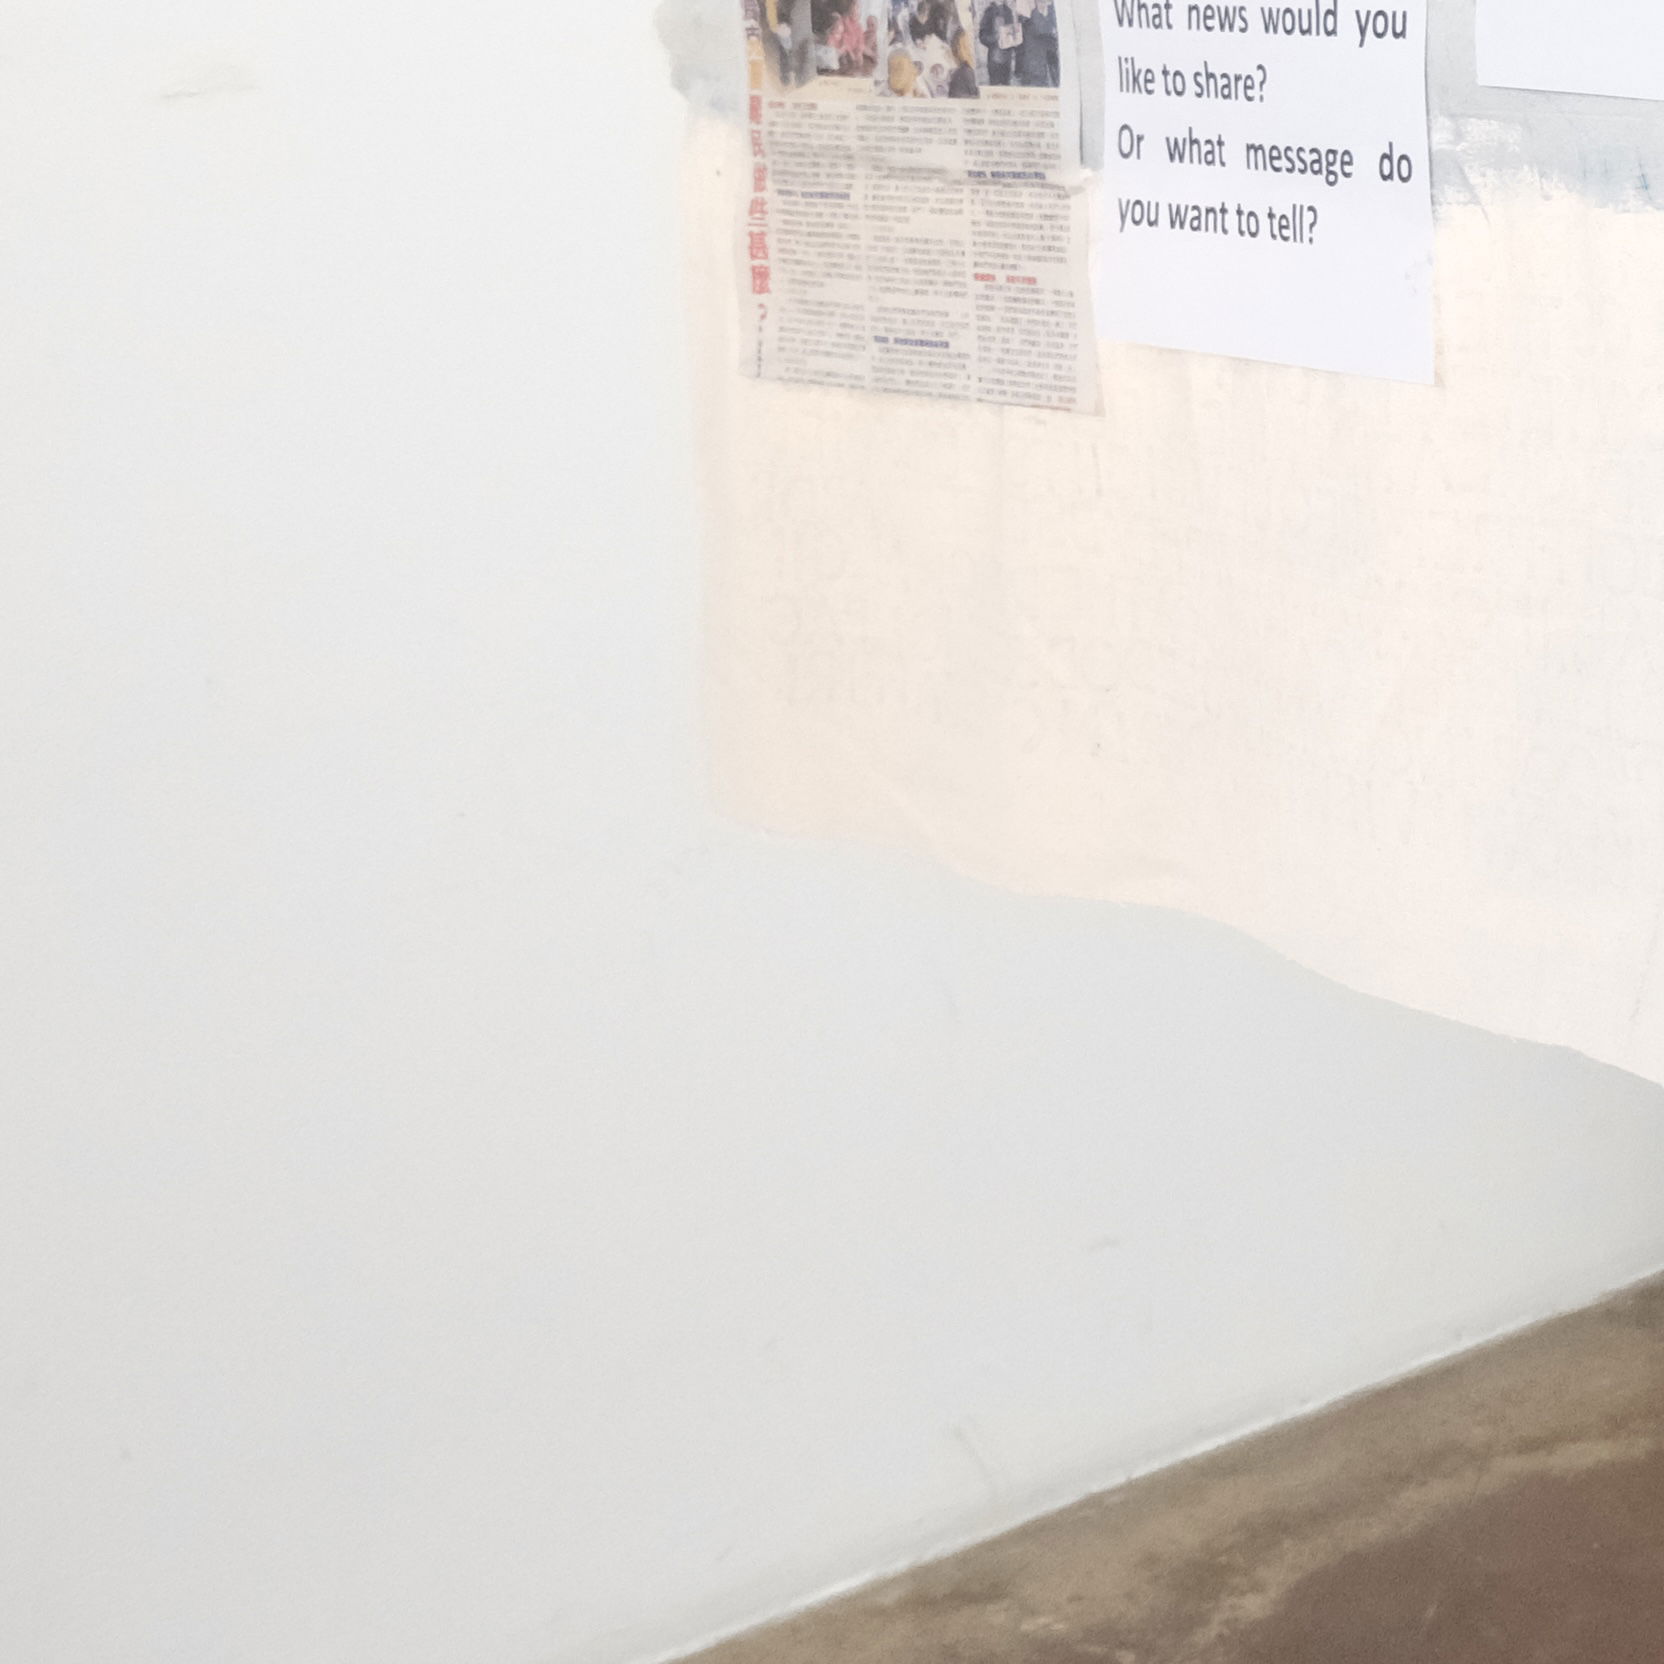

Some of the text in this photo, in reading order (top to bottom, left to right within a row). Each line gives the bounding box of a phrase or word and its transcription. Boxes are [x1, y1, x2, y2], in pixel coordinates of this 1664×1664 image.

[1187, 3, 1249, 34] news
[1355, 9, 1408, 48] you
[1118, 56, 1267, 102] like to share?
[1118, 124, 1413, 187] Or what message do
[1118, 198, 1318, 245] you want to tell?
